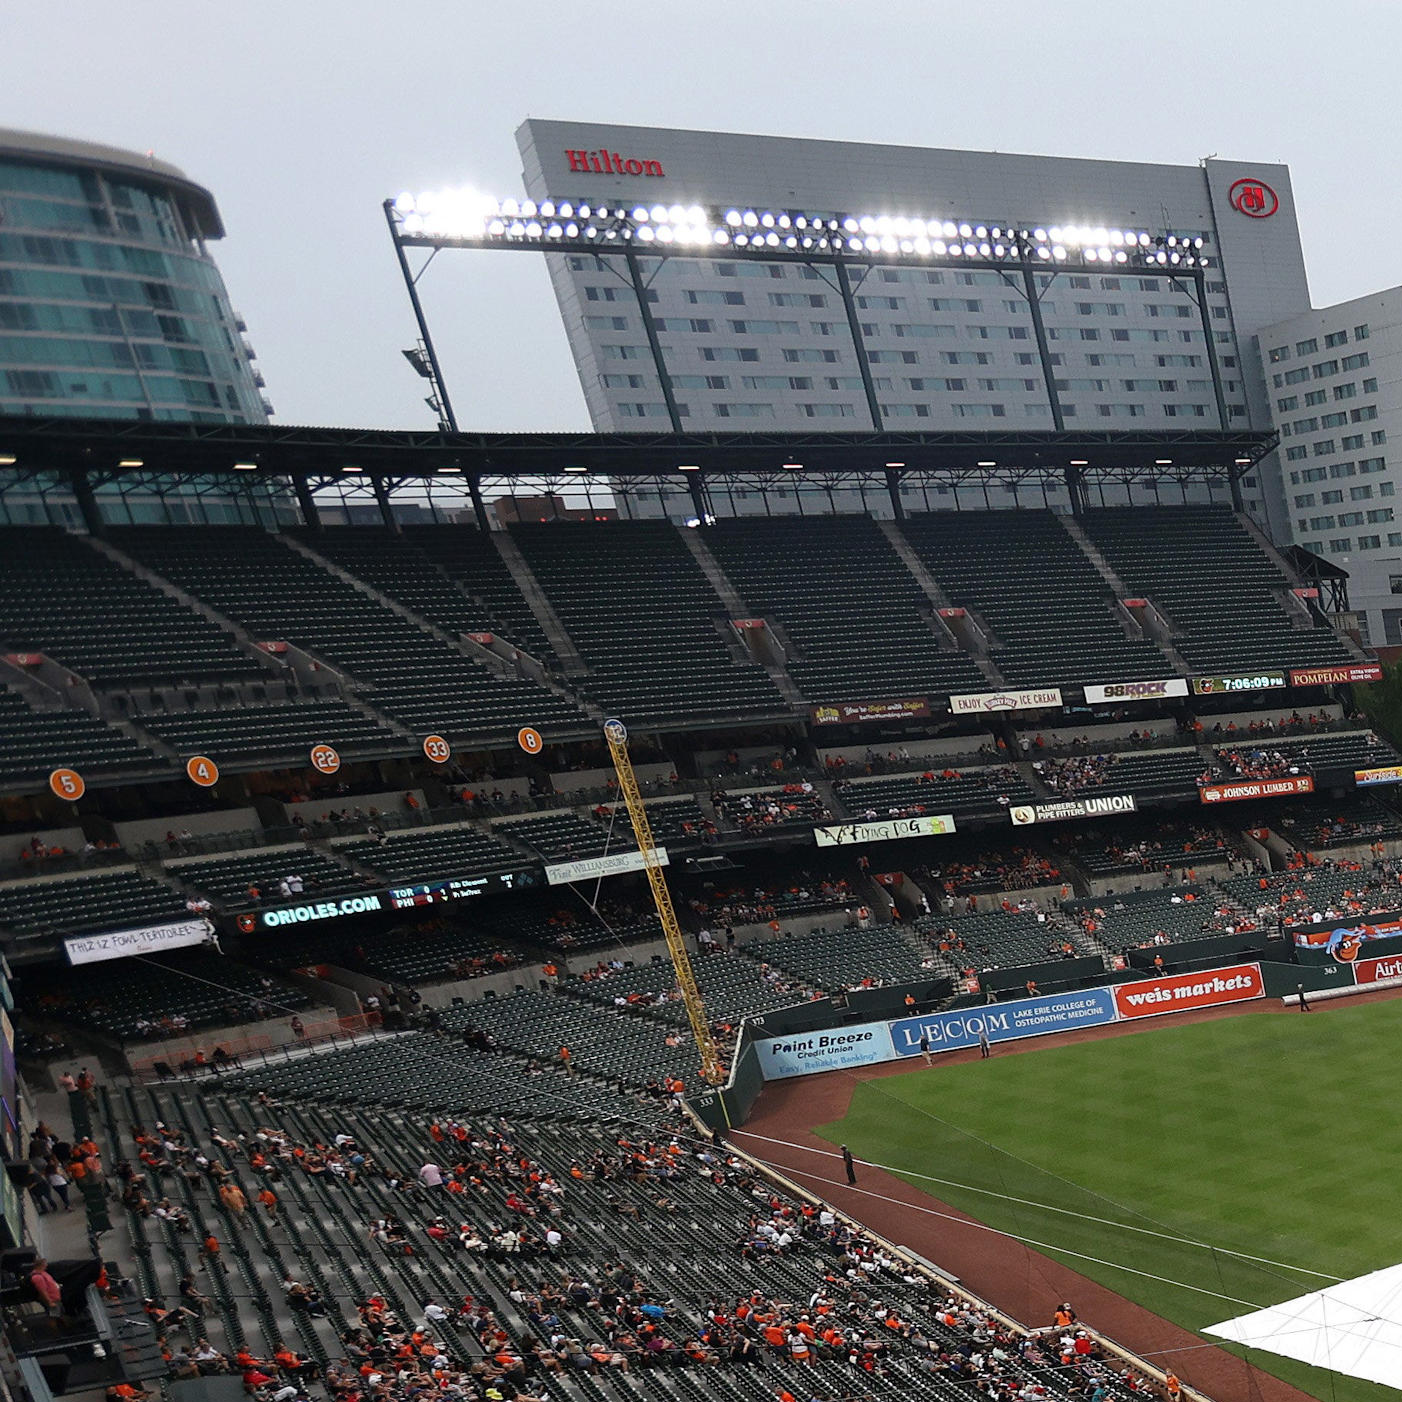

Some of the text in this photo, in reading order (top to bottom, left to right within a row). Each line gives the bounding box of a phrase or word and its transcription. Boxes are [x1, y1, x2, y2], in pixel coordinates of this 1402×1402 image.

[565, 149, 665, 177] Hilton
[1222, 676, 1269, 691] 7:06:09
[1293, 671, 1348, 686] POMPEIAN
[958, 693, 1057, 710] ENJOY ICE CREAM
[525, 733, 536, 747] 8
[427, 741, 447, 757] 33
[316, 751, 336, 768] 22
[197, 763, 209, 779] 4
[61, 775, 76, 793] 5
[1222, 785, 1260, 798] JOHNSON
[1263, 782, 1294, 794] LUMBER
[1036, 803, 1076, 813] PLUMBERS
[1085, 795, 1134, 813] UNION
[1038, 808, 1085, 820] PIPE FITTERS
[893, 819, 920, 837] DOG
[394, 887, 414, 898] TOR
[263, 895, 381, 927] ORIOLES.COM
[396, 898, 415, 908] PHI
[1126, 973, 1252, 1007] weis markets
[1013, 998, 1097, 1019] LAKE ERIE COLLEGE OF
[1015, 1006, 1104, 1029] OSTEOPATHIC MEDICINE
[772, 1030, 873, 1055] Point Breeze
[797, 1044, 853, 1060] Credit Union
